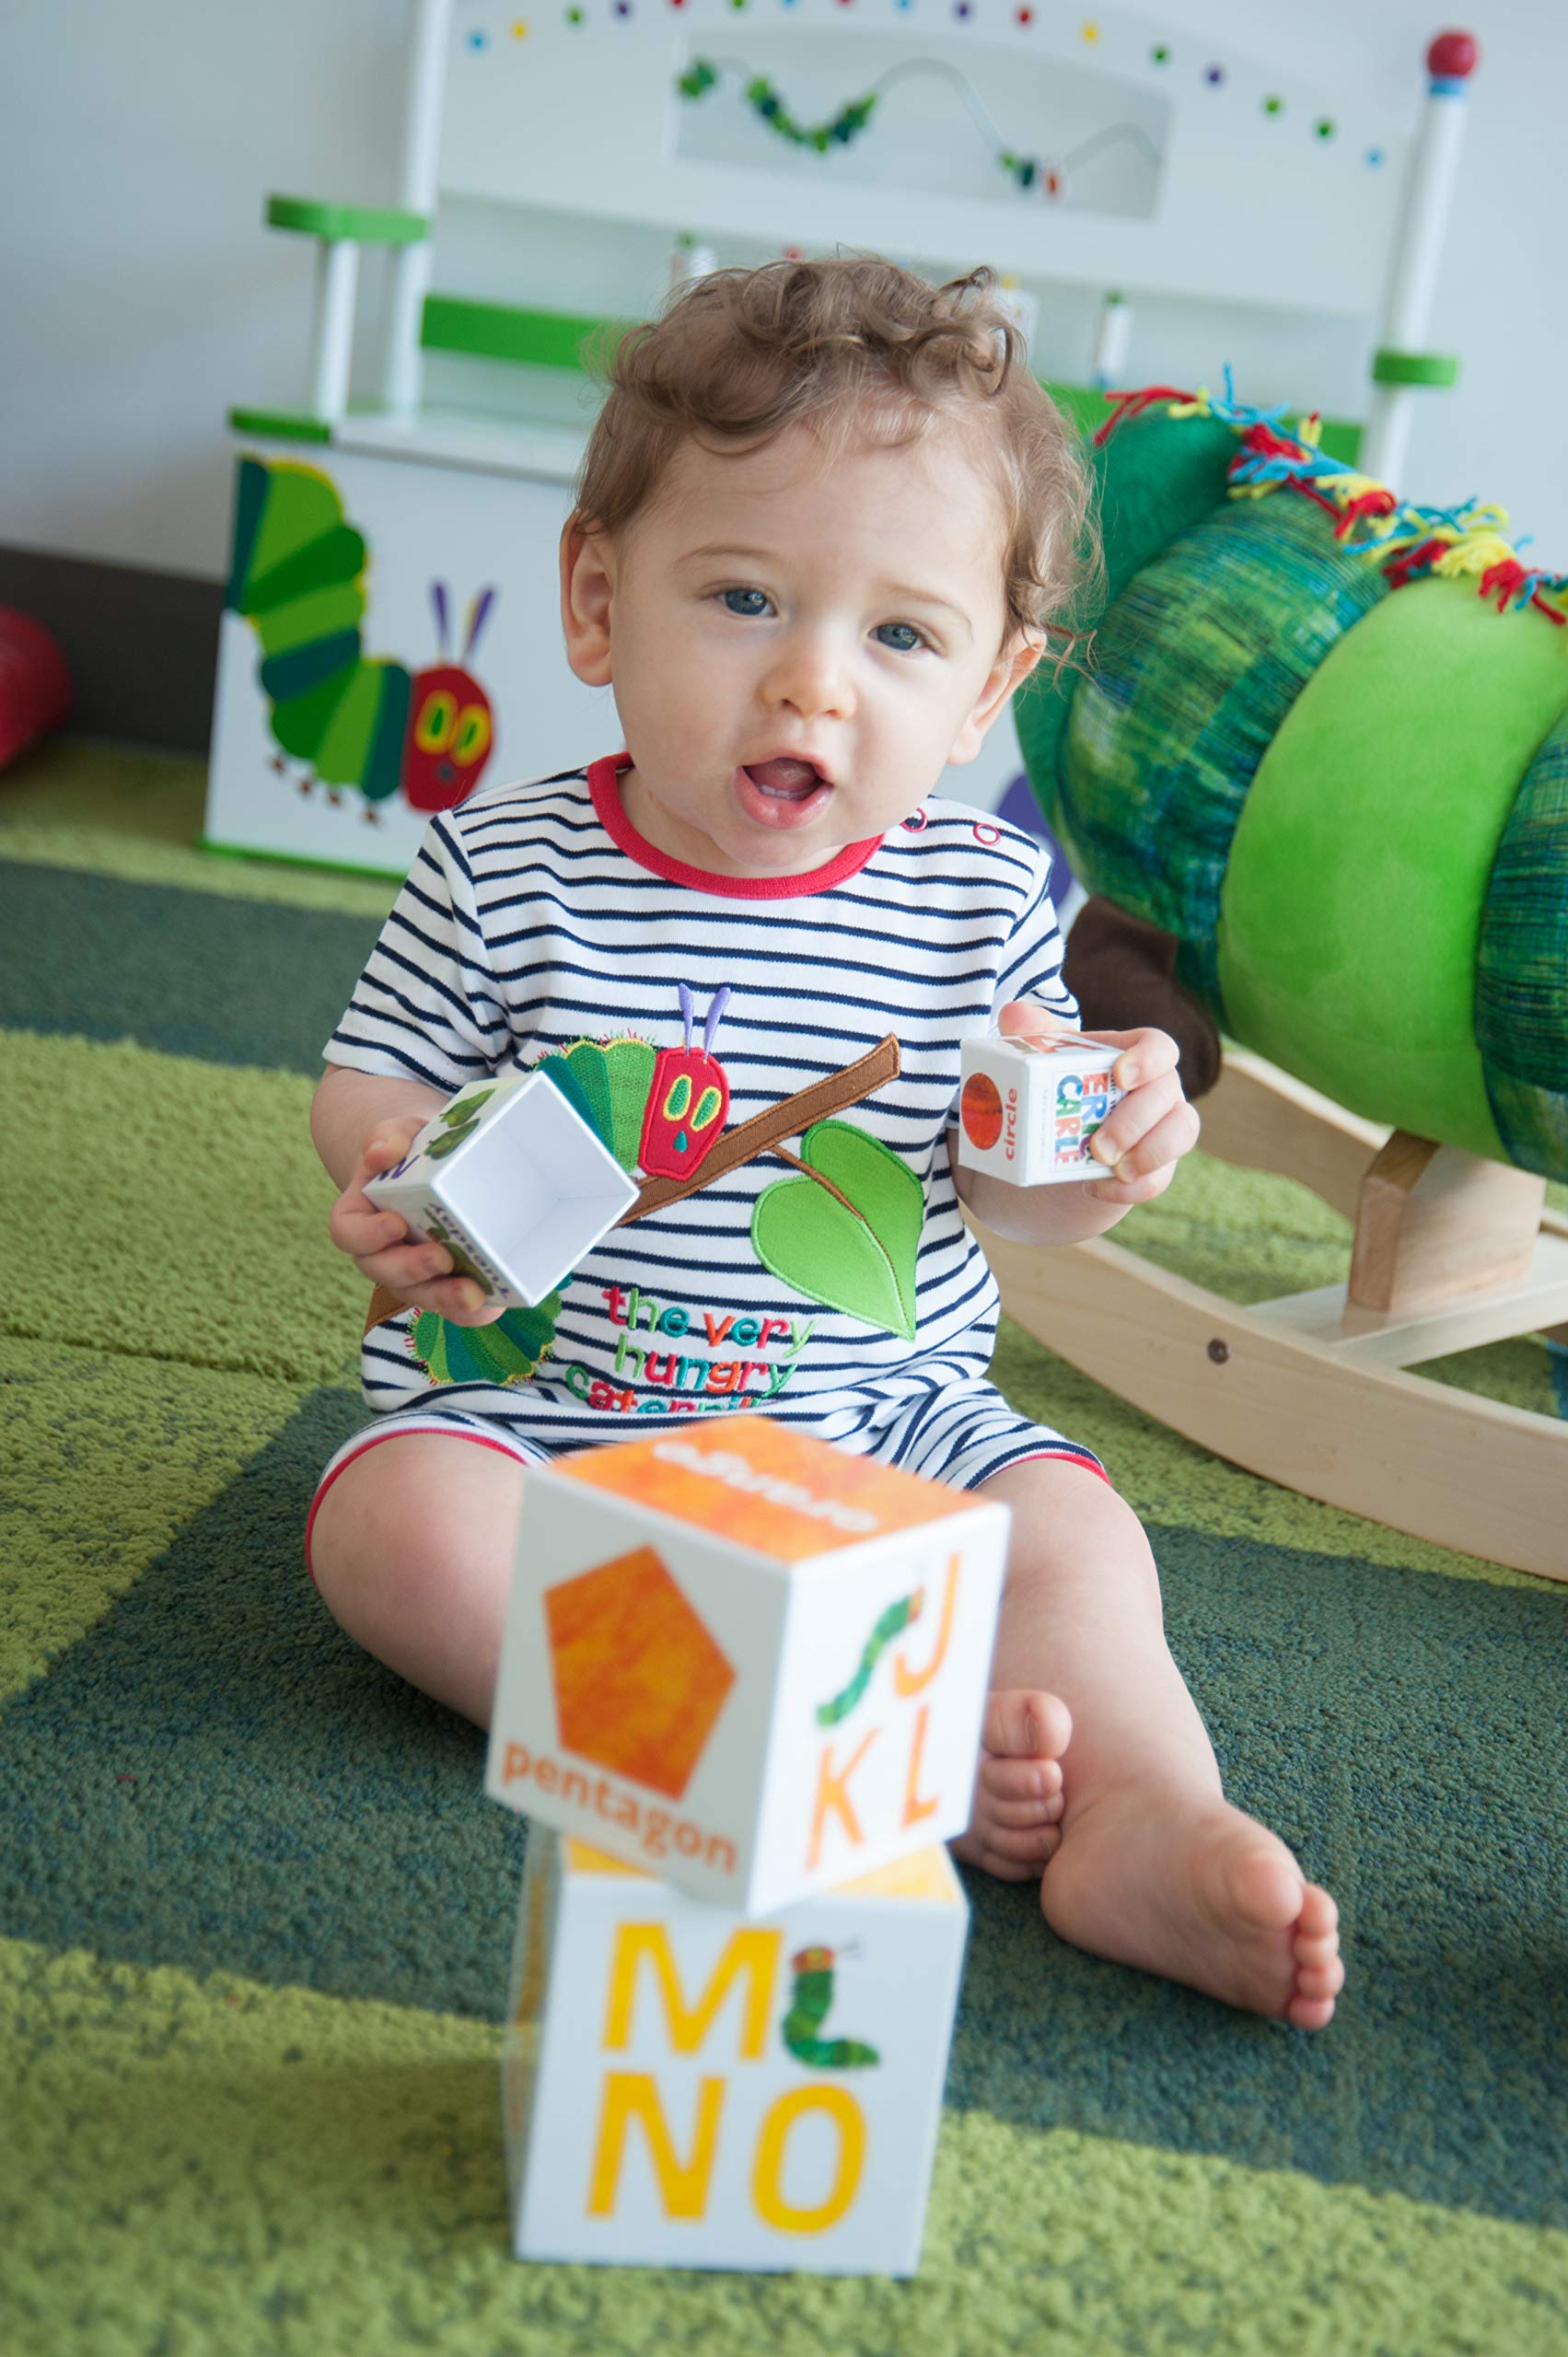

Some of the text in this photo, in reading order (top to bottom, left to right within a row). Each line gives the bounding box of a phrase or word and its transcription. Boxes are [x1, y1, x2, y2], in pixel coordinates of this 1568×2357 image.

[1004, 1088, 1018, 1160] circle
[1054, 1075, 1083, 1164] CARLE
[602, 1286, 817, 1358] the very
[614, 1333, 797, 1399] hungry
[502, 1741, 736, 1875] pentagon
[600, 1922, 784, 2061] M
